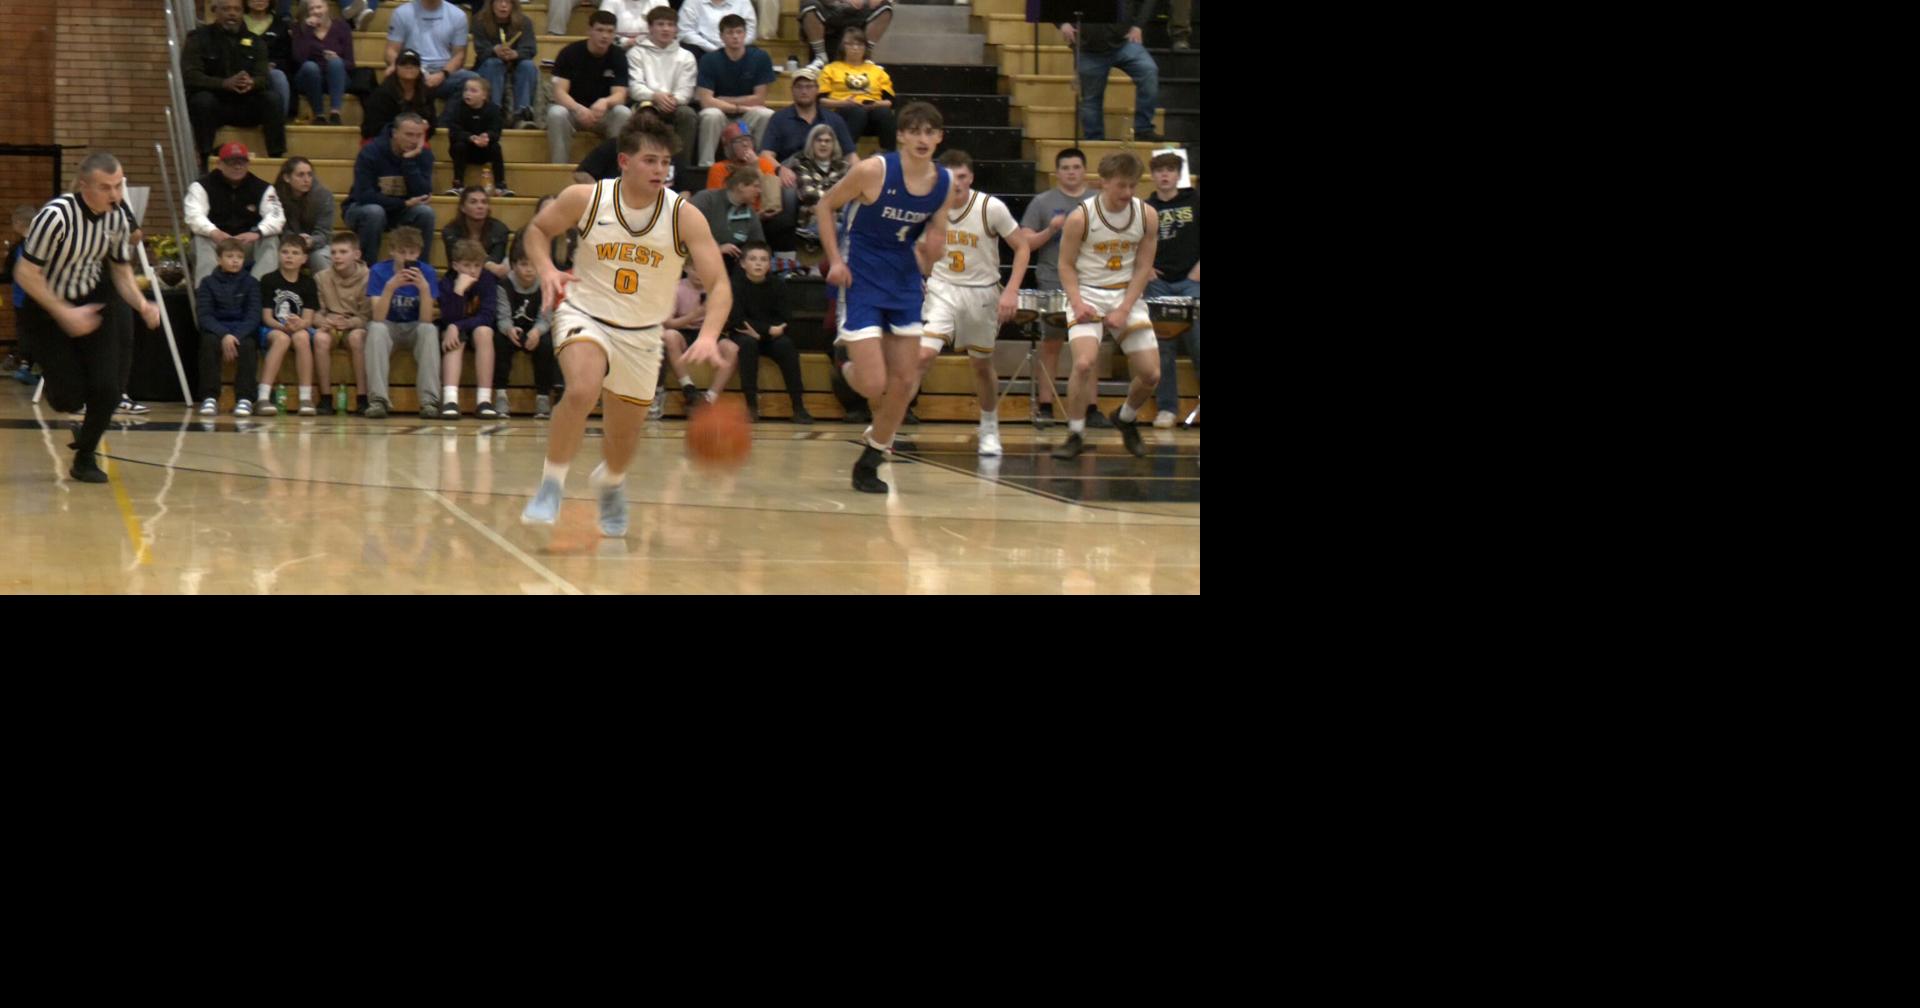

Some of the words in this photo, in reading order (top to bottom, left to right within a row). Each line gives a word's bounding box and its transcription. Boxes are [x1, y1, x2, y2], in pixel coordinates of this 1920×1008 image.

[945, 230, 979, 248] EST
[595, 242, 664, 268] WEST
[947, 250, 966, 273] 3
[613, 267, 639, 295] 0
